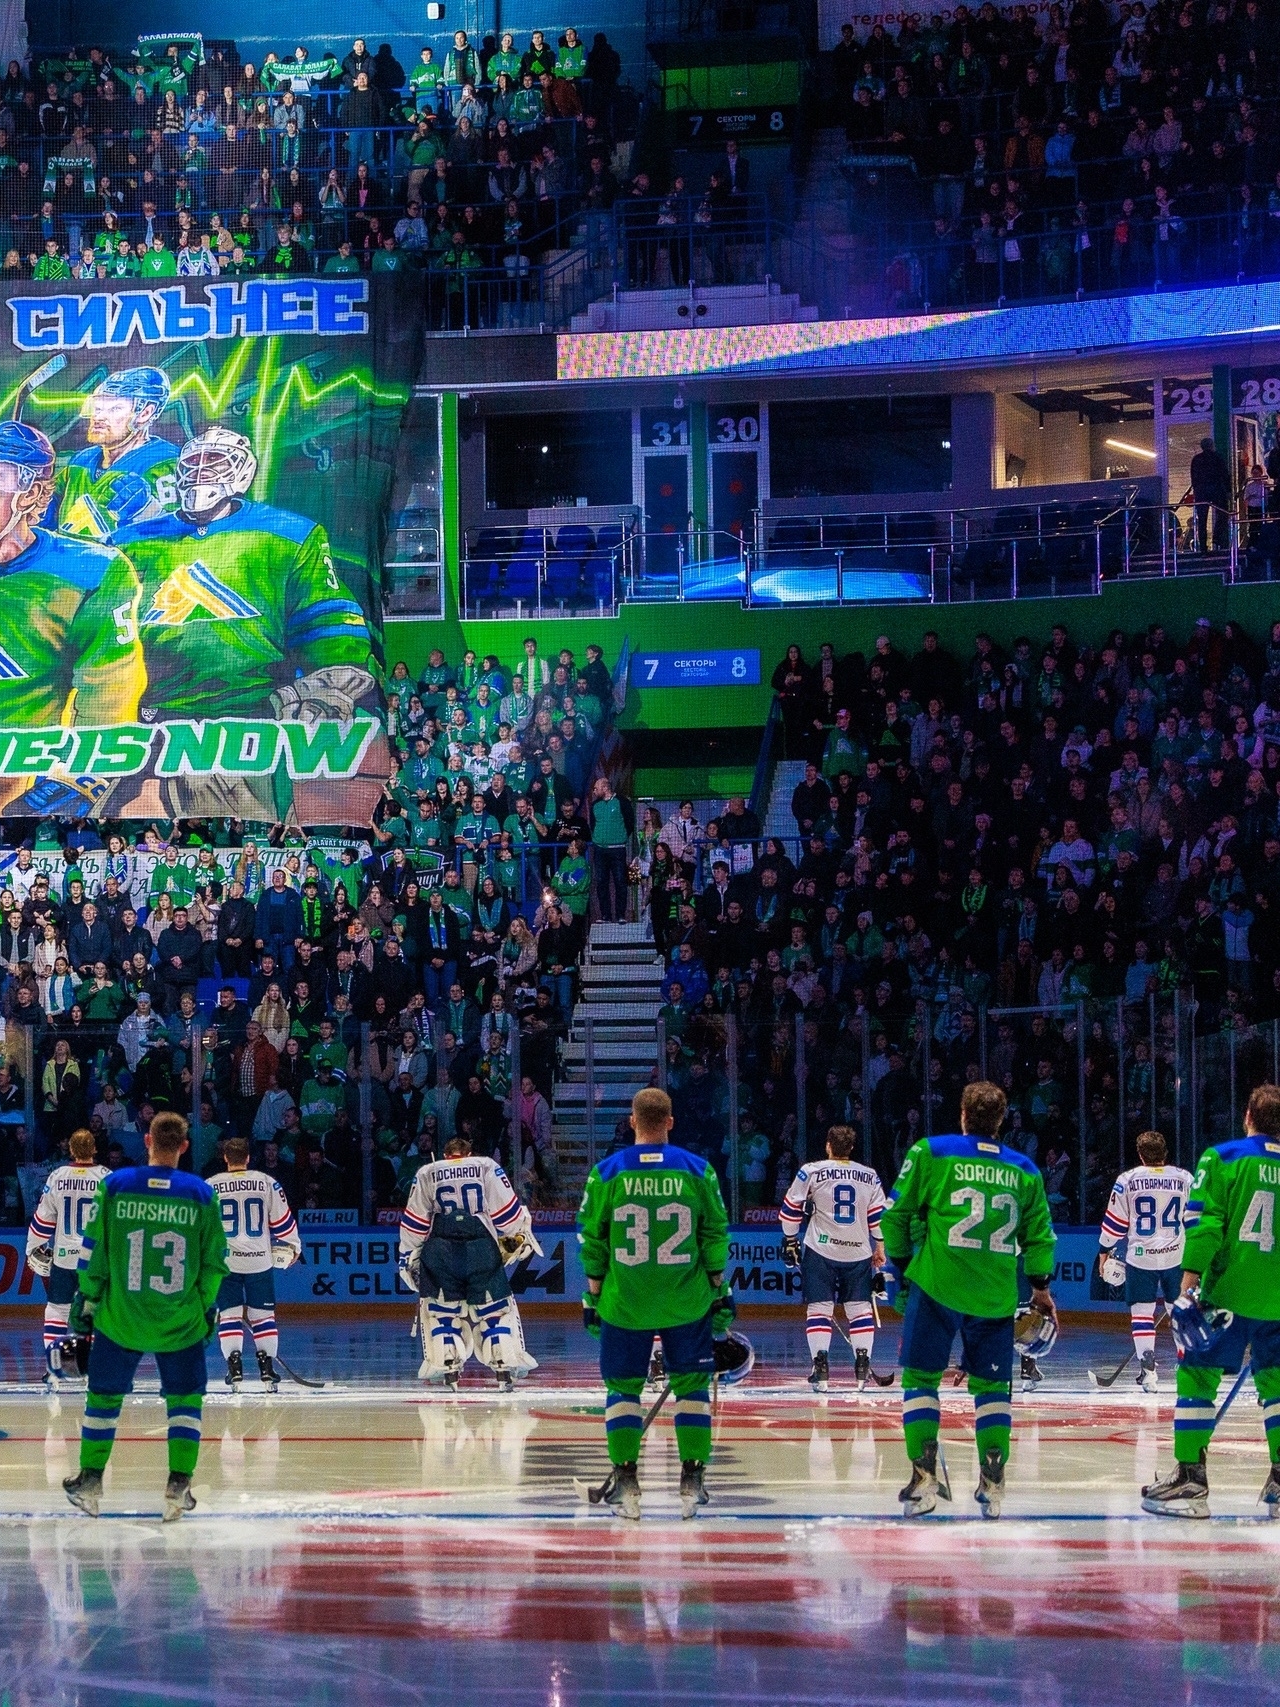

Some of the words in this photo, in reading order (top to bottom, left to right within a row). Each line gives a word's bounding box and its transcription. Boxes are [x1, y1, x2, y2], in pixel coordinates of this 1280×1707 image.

[689, 116, 703, 135] 7
[717, 114, 756, 123] СЕКТОРЫ
[770, 112, 784, 131] 8
[6, 278, 370, 351] СИЛЬНЕЕ
[1171, 386, 1212, 414] 29
[1240, 379, 1280, 407] 28
[652, 420, 688, 446] 31
[717, 416, 758, 443] 30
[644, 660, 659, 680] 7
[732, 657, 746, 677] 8
[63, 724, 154, 777] IS
[156, 718, 374, 781] NOW
[214, 1180, 259, 1194] BELOUSOV
[623, 1177, 683, 1196] VARLOV
[815, 1169, 873, 1185] ZEMCHYONOK
[954, 1163, 1019, 1189] SOROKIN
[436, 1183, 483, 1215] 60
[833, 1184, 856, 1225] 8
[64, 1196, 95, 1236] 10
[116, 1200, 198, 1226] GORSHKOV
[219, 1198, 264, 1237] 90
[302, 1212, 353, 1223] KHL.RU
[744, 1209, 780, 1223] FONB
[948, 1186, 1019, 1254] 22
[1135, 1196, 1181, 1236] 84
[613, 1202, 692, 1266] 32
[830, 1238, 863, 1248] ПОЛИПЛАСТ
[127, 1228, 187, 1295] 13
[1145, 1244, 1180, 1255] ПОЛИПЛАСТ
[312, 1273, 336, 1296] &
